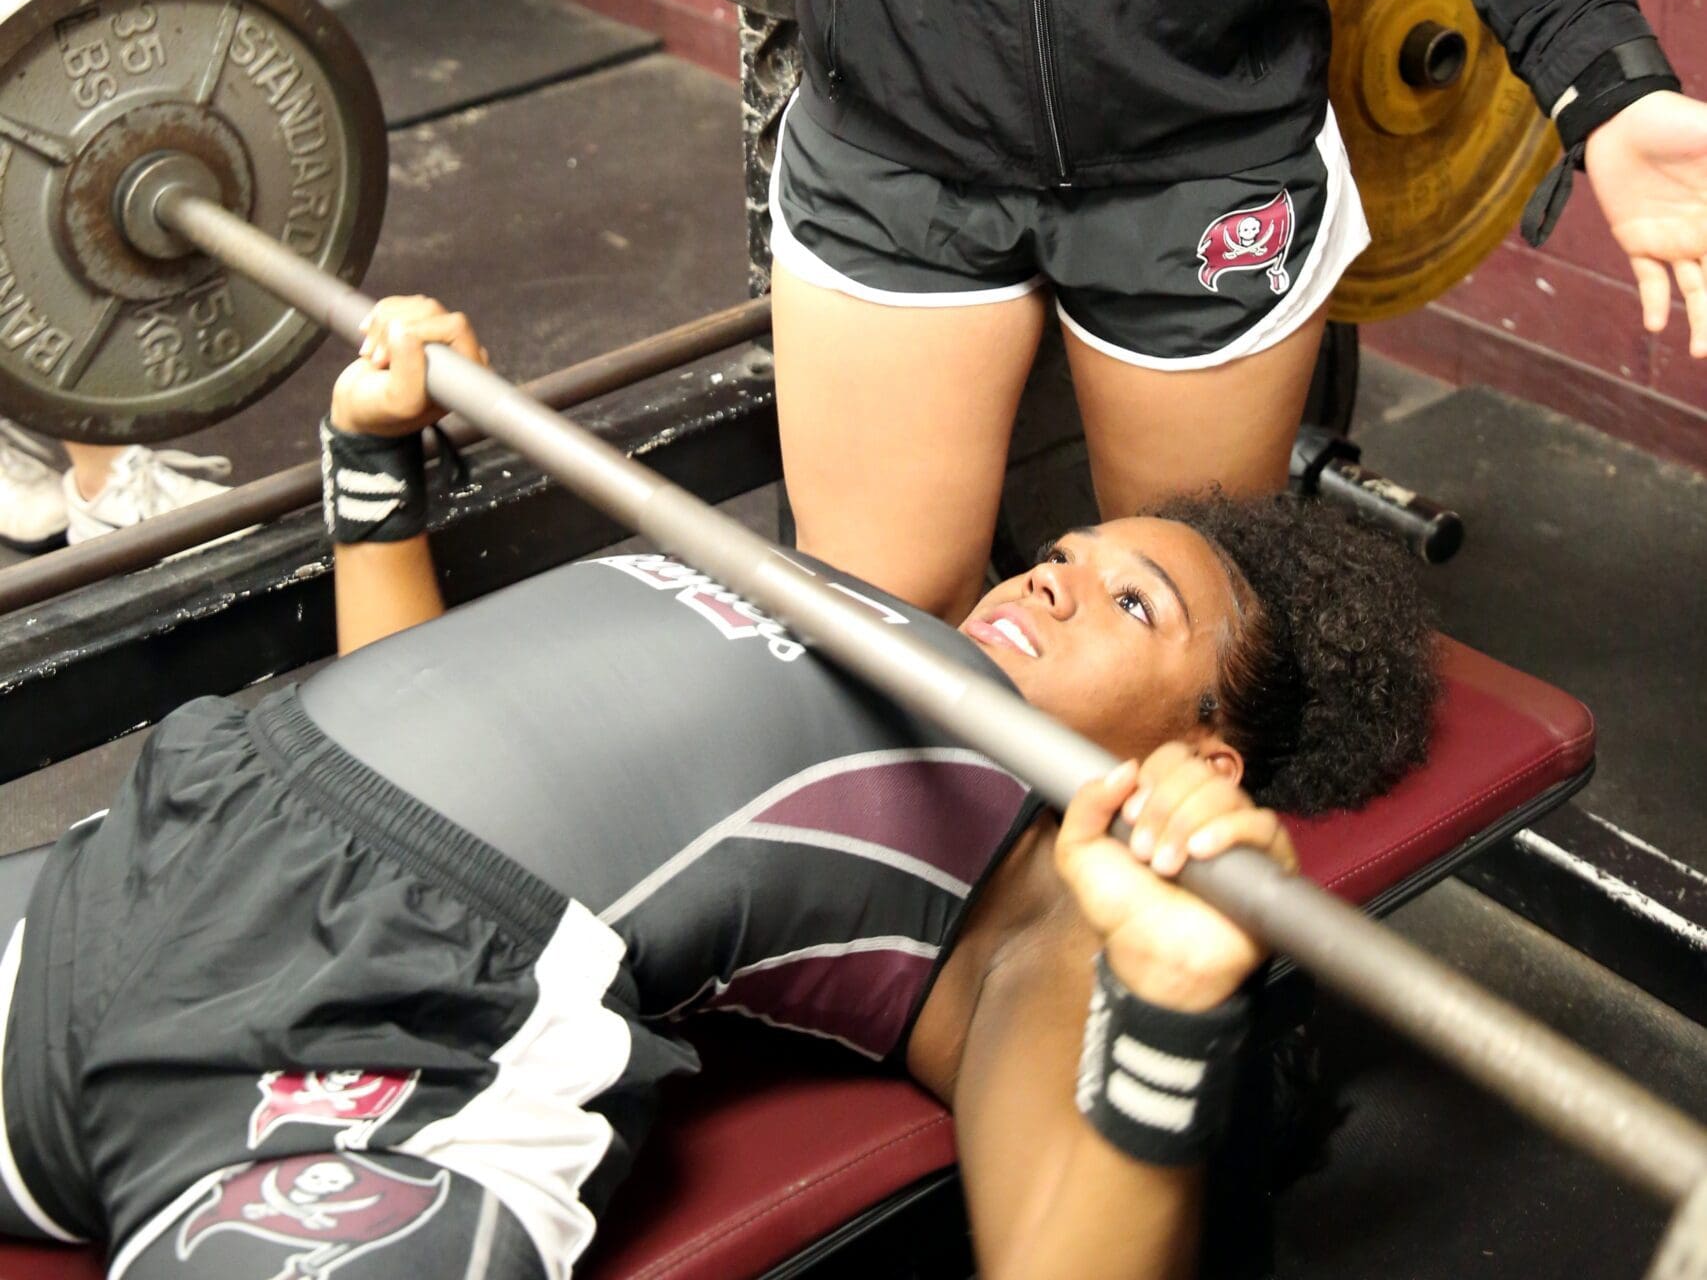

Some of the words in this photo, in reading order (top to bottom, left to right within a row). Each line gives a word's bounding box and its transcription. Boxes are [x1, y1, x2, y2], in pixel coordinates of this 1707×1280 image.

[54, 7, 118, 108] LBS
[111, 2, 167, 75] 35
[229, 18, 334, 257] STANDARD
[135, 299, 191, 389] KGS
